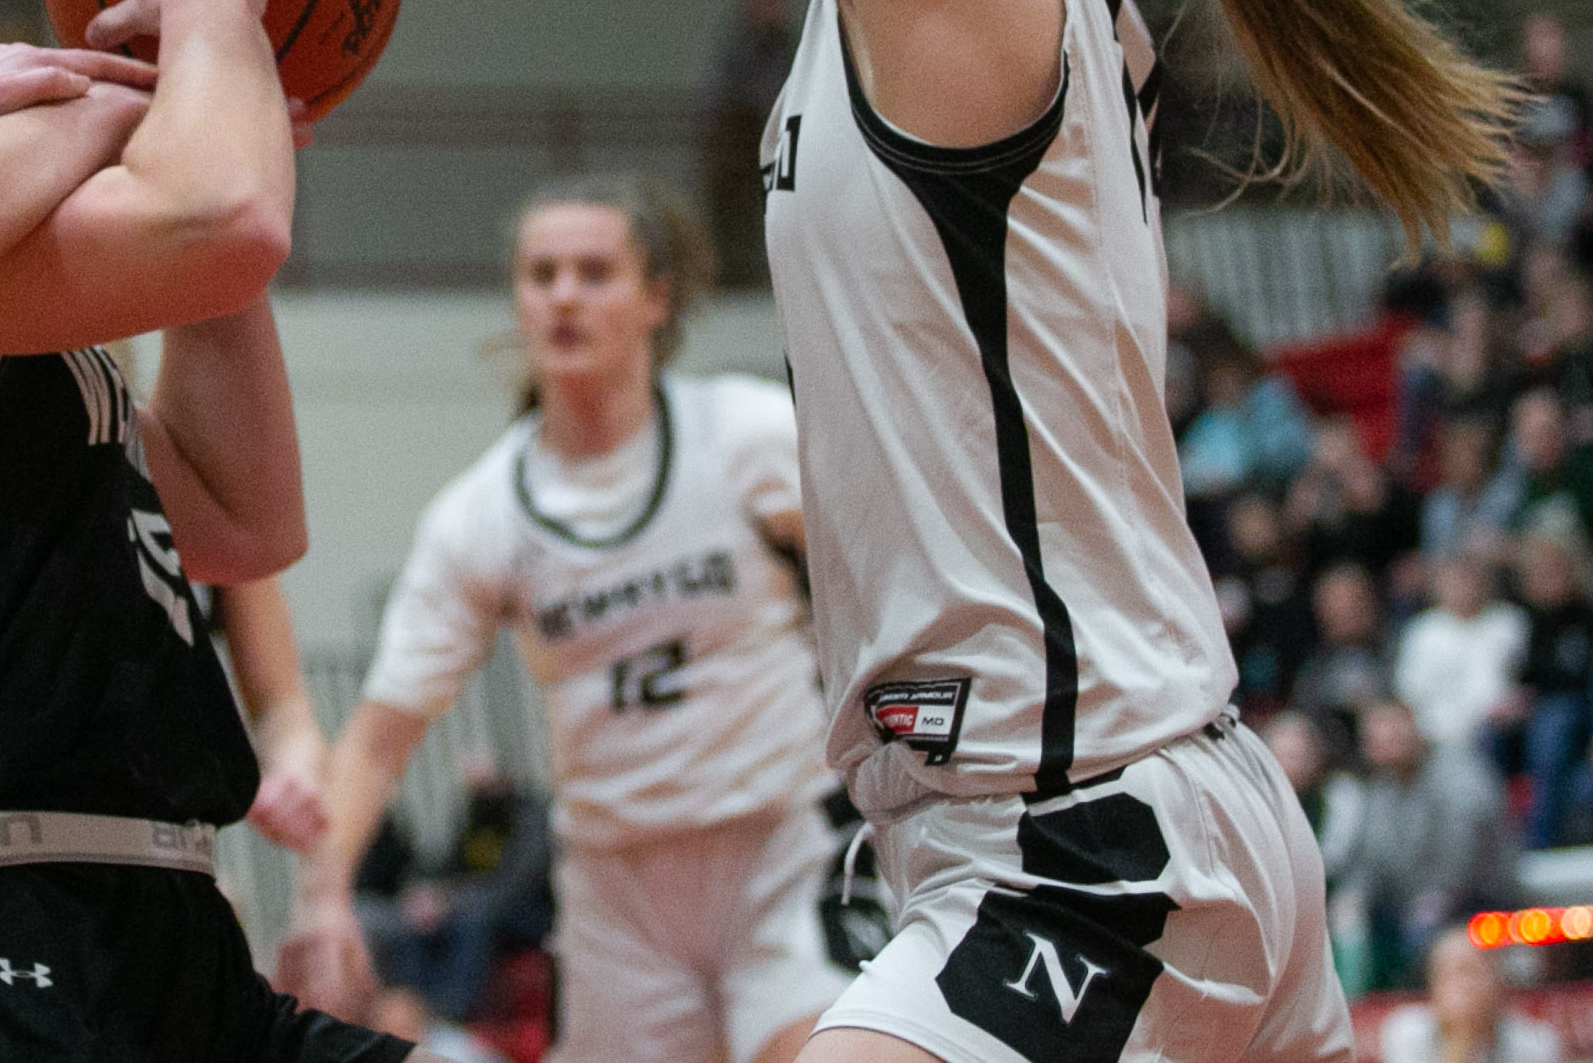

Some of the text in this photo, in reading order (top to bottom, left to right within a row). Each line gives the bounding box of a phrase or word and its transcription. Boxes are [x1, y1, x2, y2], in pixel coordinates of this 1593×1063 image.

[608, 636, 690, 714] 12
[921, 716, 945, 727] MD
[1005, 932, 1109, 1025] N
